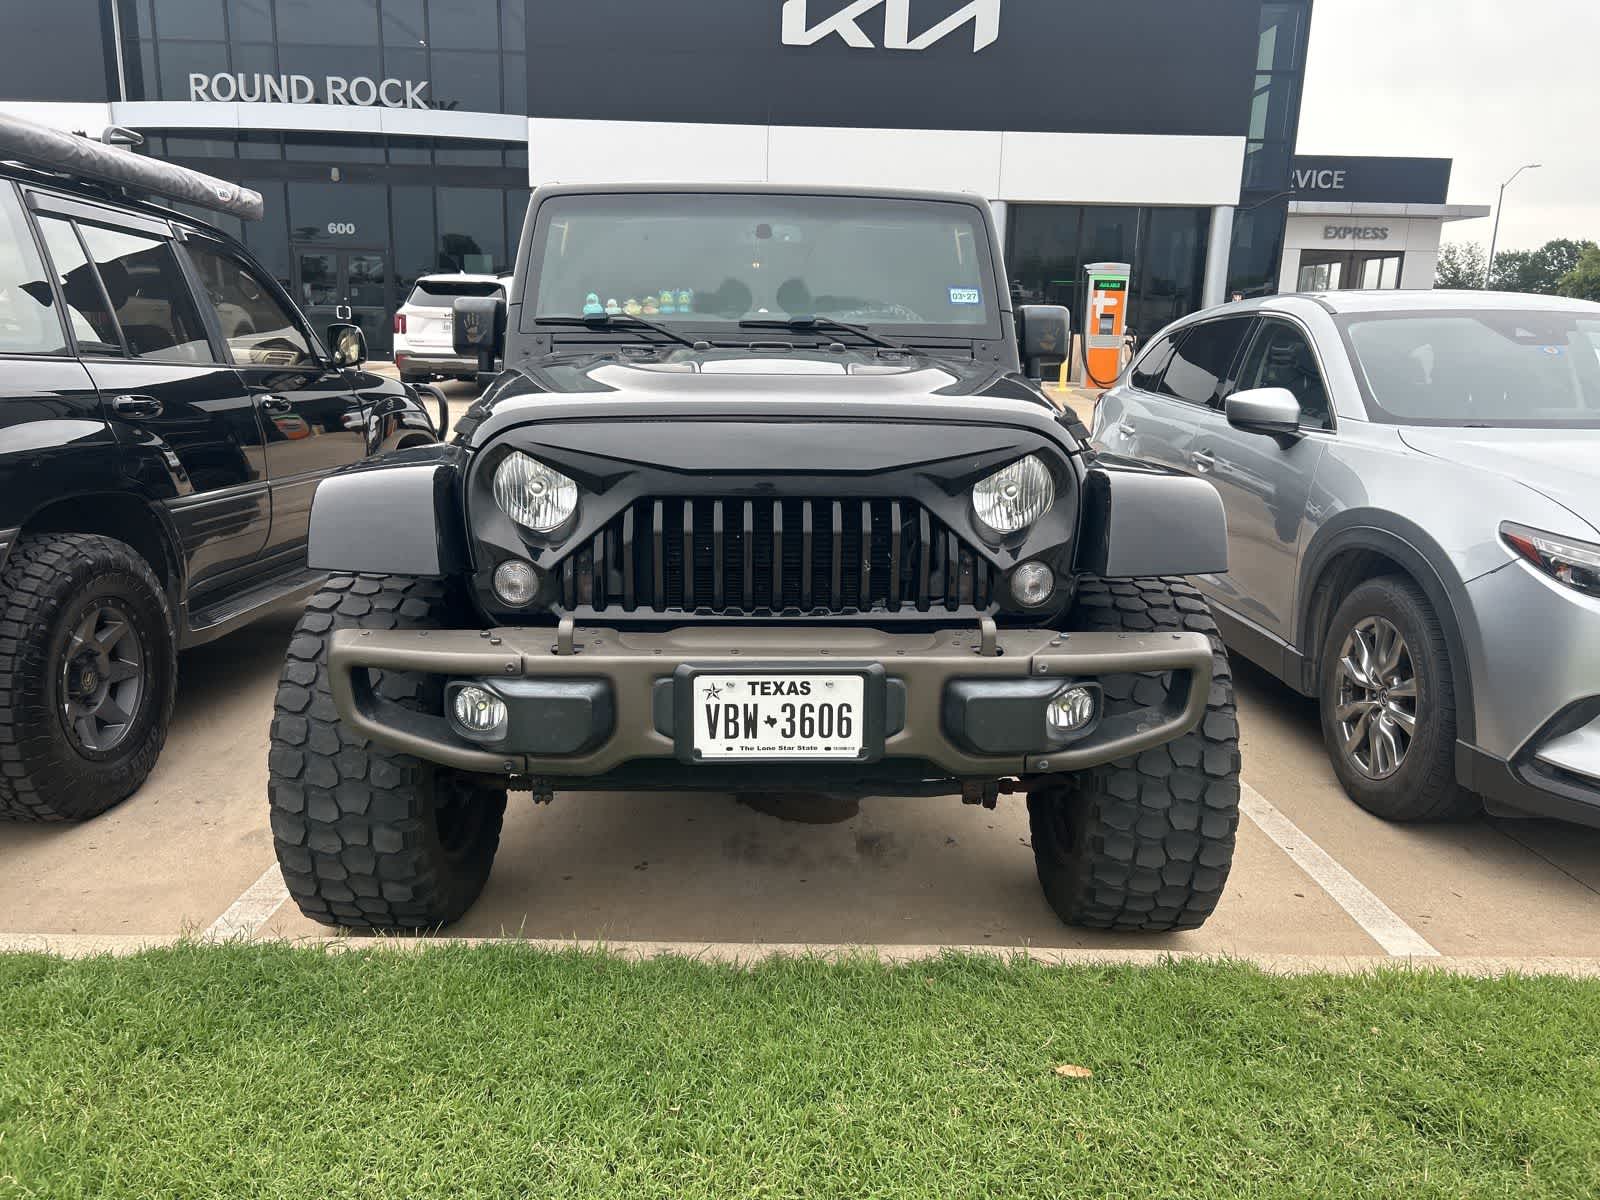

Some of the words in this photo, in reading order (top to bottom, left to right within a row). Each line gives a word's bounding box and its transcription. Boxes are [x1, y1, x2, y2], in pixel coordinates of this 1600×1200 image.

[189, 72, 315, 105] ROUND
[326, 75, 429, 110] ROCK
[327, 222, 356, 235] 600
[1324, 225, 1389, 240] EXPRESS
[747, 680, 812, 697] TEXAS
[705, 703, 759, 740] VBW
[780, 702, 853, 740] 3606
